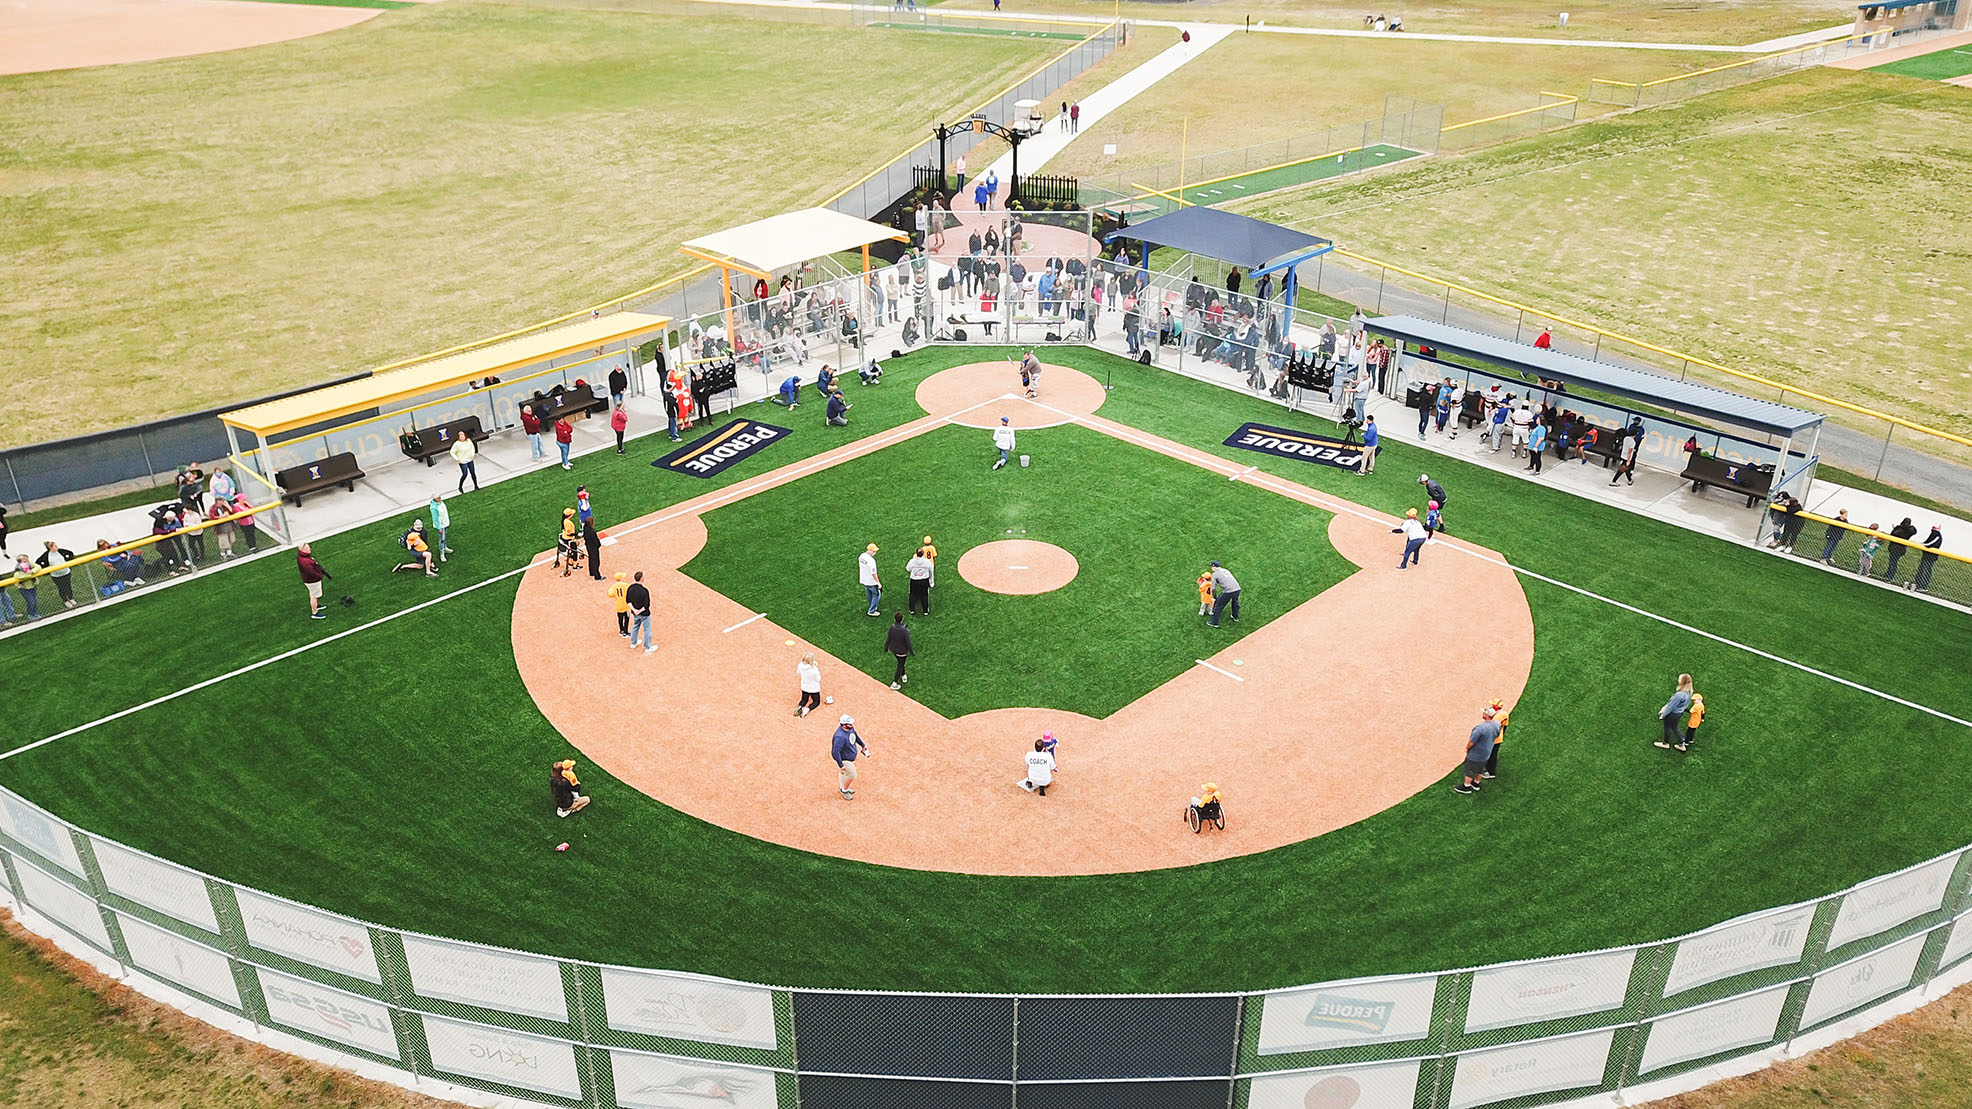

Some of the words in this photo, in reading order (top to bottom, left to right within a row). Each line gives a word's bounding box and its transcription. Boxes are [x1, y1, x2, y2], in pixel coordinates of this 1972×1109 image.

[685, 425, 779, 473] PERDUE
[1237, 433, 1363, 467] PERDUE
[926, 550, 932, 560] 8
[616, 587, 623, 597] 11
[1206, 587, 1211, 595] 4
